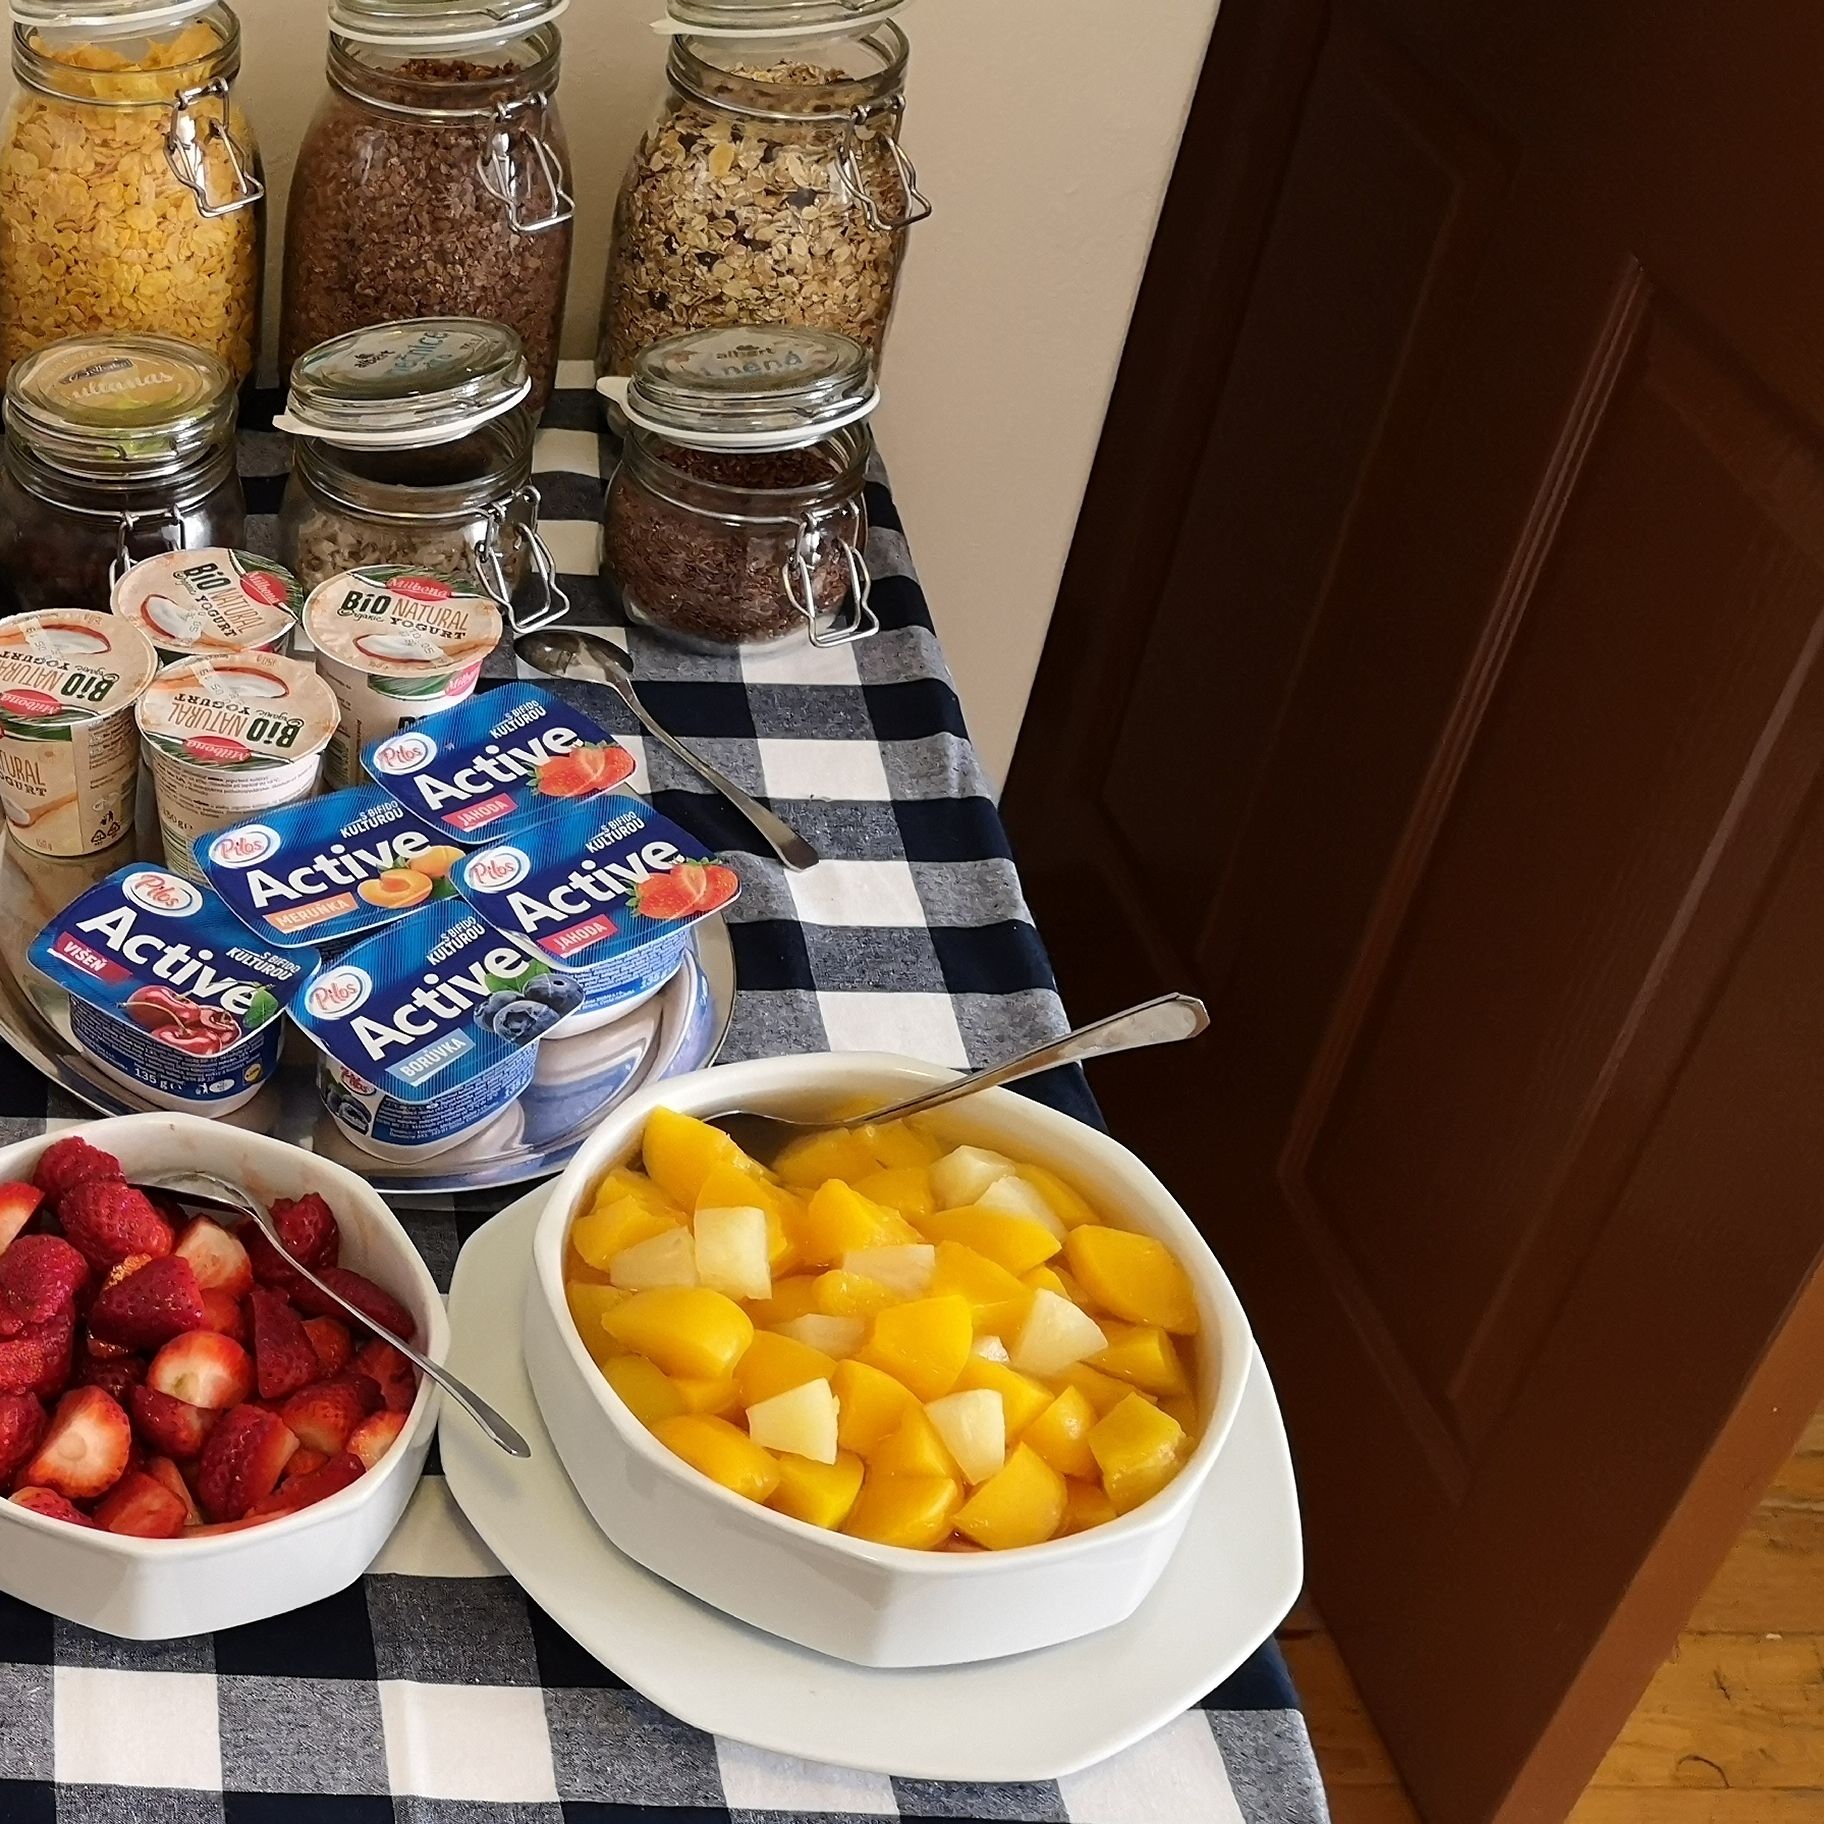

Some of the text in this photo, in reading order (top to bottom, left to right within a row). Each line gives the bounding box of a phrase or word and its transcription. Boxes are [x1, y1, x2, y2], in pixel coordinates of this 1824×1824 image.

[388, 578, 450, 598] Milbona
[195, 594, 238, 638] YOGURT
[208, 587, 266, 634] NATURAL
[392, 598, 470, 632] NATURAL
[390, 616, 467, 640] YOGURT
[0, 691, 62, 716] Milbona
[174, 693, 251, 715] YOGURT
[512, 699, 540, 718] BIFIDO
[167, 702, 248, 737] NATURAL
[489, 705, 547, 740] KULTUROU
[185, 740, 253, 763] Milbona
[377, 745, 422, 768] Pilos
[413, 727, 580, 812] Active
[339, 807, 404, 839] KULTUROU
[367, 800, 399, 818] BIFIDO
[460, 799, 508, 827] JAHODA
[608, 811, 638, 831] BIFIDO
[219, 836, 265, 861] Pilos
[585, 817, 646, 854] KULTUROU
[246, 831, 434, 909] Active
[471, 858, 515, 884] Pilos
[136, 874, 181, 907] Pilos
[506, 841, 680, 934] Active
[275, 898, 351, 928] MERUŇKA
[448, 916, 477, 938] BIFIDO
[426, 922, 487, 966] KULTUROU
[554, 922, 609, 951] JAHODA
[63, 940, 108, 972] VIŠEŇ
[76, 905, 253, 1016] Active
[226, 947, 293, 981] KULTUROU
[267, 953, 302, 974] BIFIDO
[311, 982, 358, 1011] Pilos
[349, 947, 530, 1062] Active
[399, 1036, 468, 1078] BORŮVKA
[134, 1067, 158, 1085] 135
